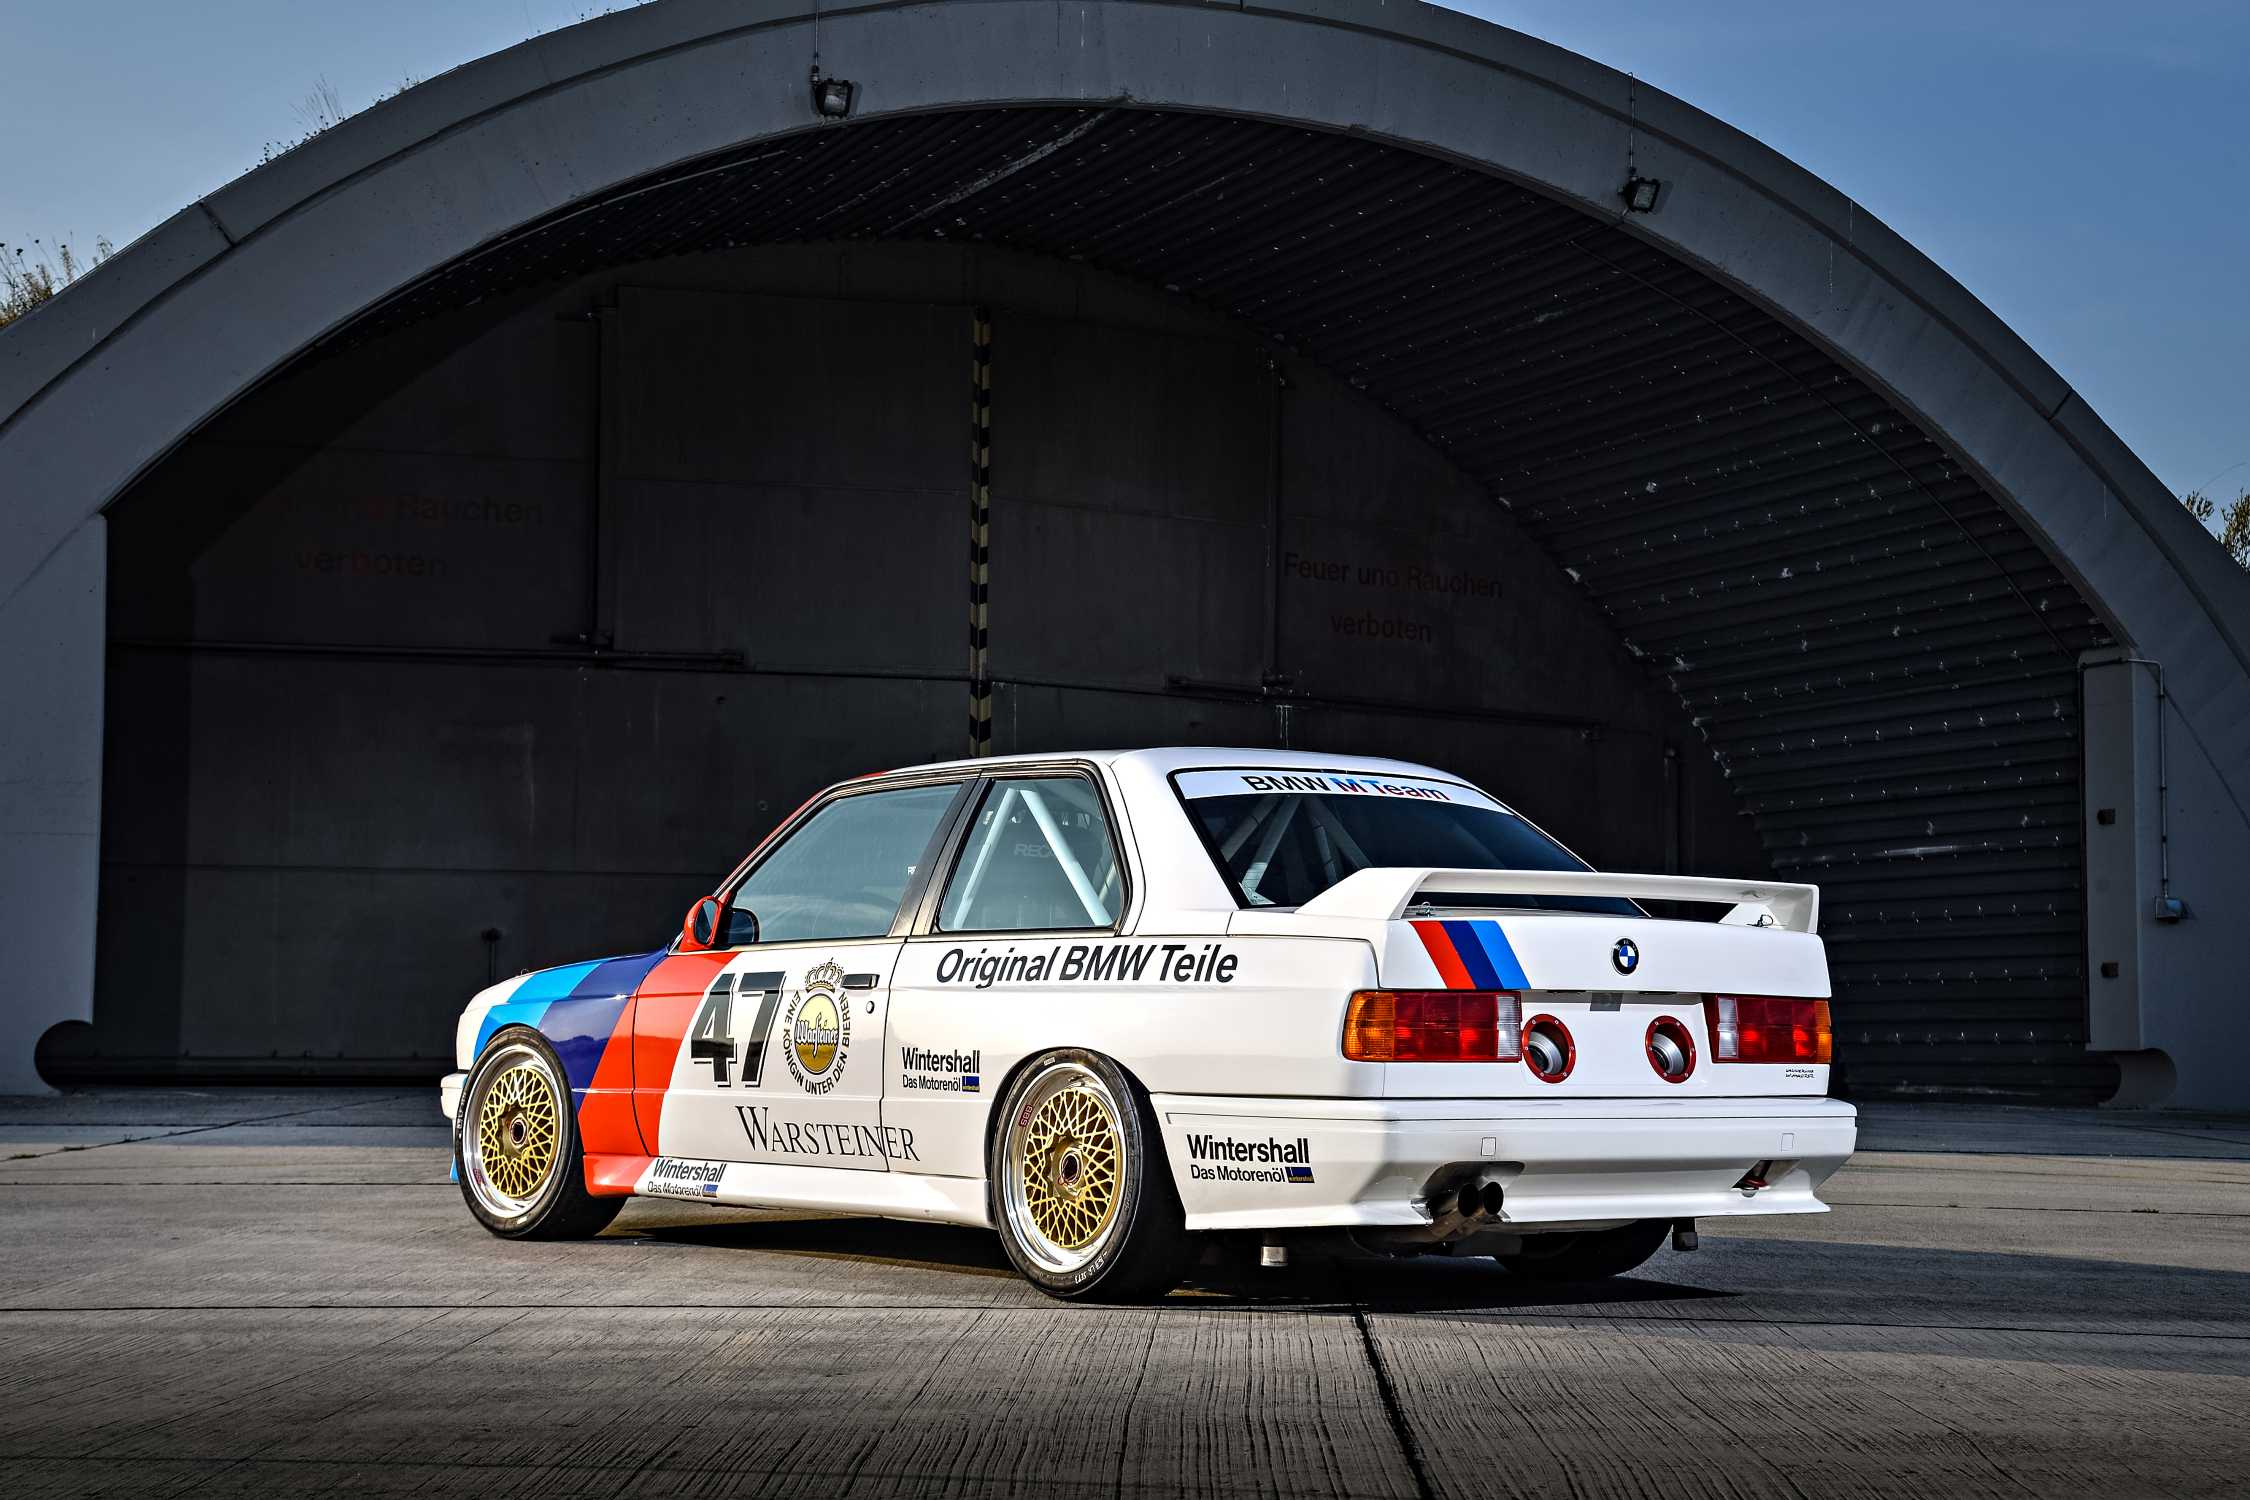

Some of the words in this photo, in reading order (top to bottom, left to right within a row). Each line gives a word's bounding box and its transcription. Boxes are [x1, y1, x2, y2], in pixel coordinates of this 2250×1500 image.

[1283, 551, 1350, 583] Feuer
[1407, 565, 1504, 599] Rauchen
[1330, 608, 1433, 643] verboten
[1241, 775, 1331, 792] BMW
[1328, 777, 1369, 793] M
[1360, 779, 1451, 801] Team
[936, 945, 1062, 989] Original
[1060, 944, 1158, 982] BMW
[1158, 944, 1239, 983] Teile
[784, 990, 801, 1025] EINE
[838, 991, 851, 1048] BIEREN
[690, 970, 787, 1088] 47
[783, 1028, 804, 1087] KÖNIGIN
[832, 1051, 848, 1083] DEN
[901, 1046, 980, 1074] Wintershall
[805, 1077, 835, 1095] UNTER
[902, 1074, 918, 1089] Das
[918, 1075, 961, 1092] Motorenöl
[735, 1105, 921, 1162] WARSTEINER
[1186, 1133, 1310, 1164] Wintershall
[653, 1158, 728, 1183] Wintershall
[1190, 1163, 1216, 1180] Das
[1216, 1165, 1286, 1183] Motorenöl
[647, 1180, 662, 1194] Das
